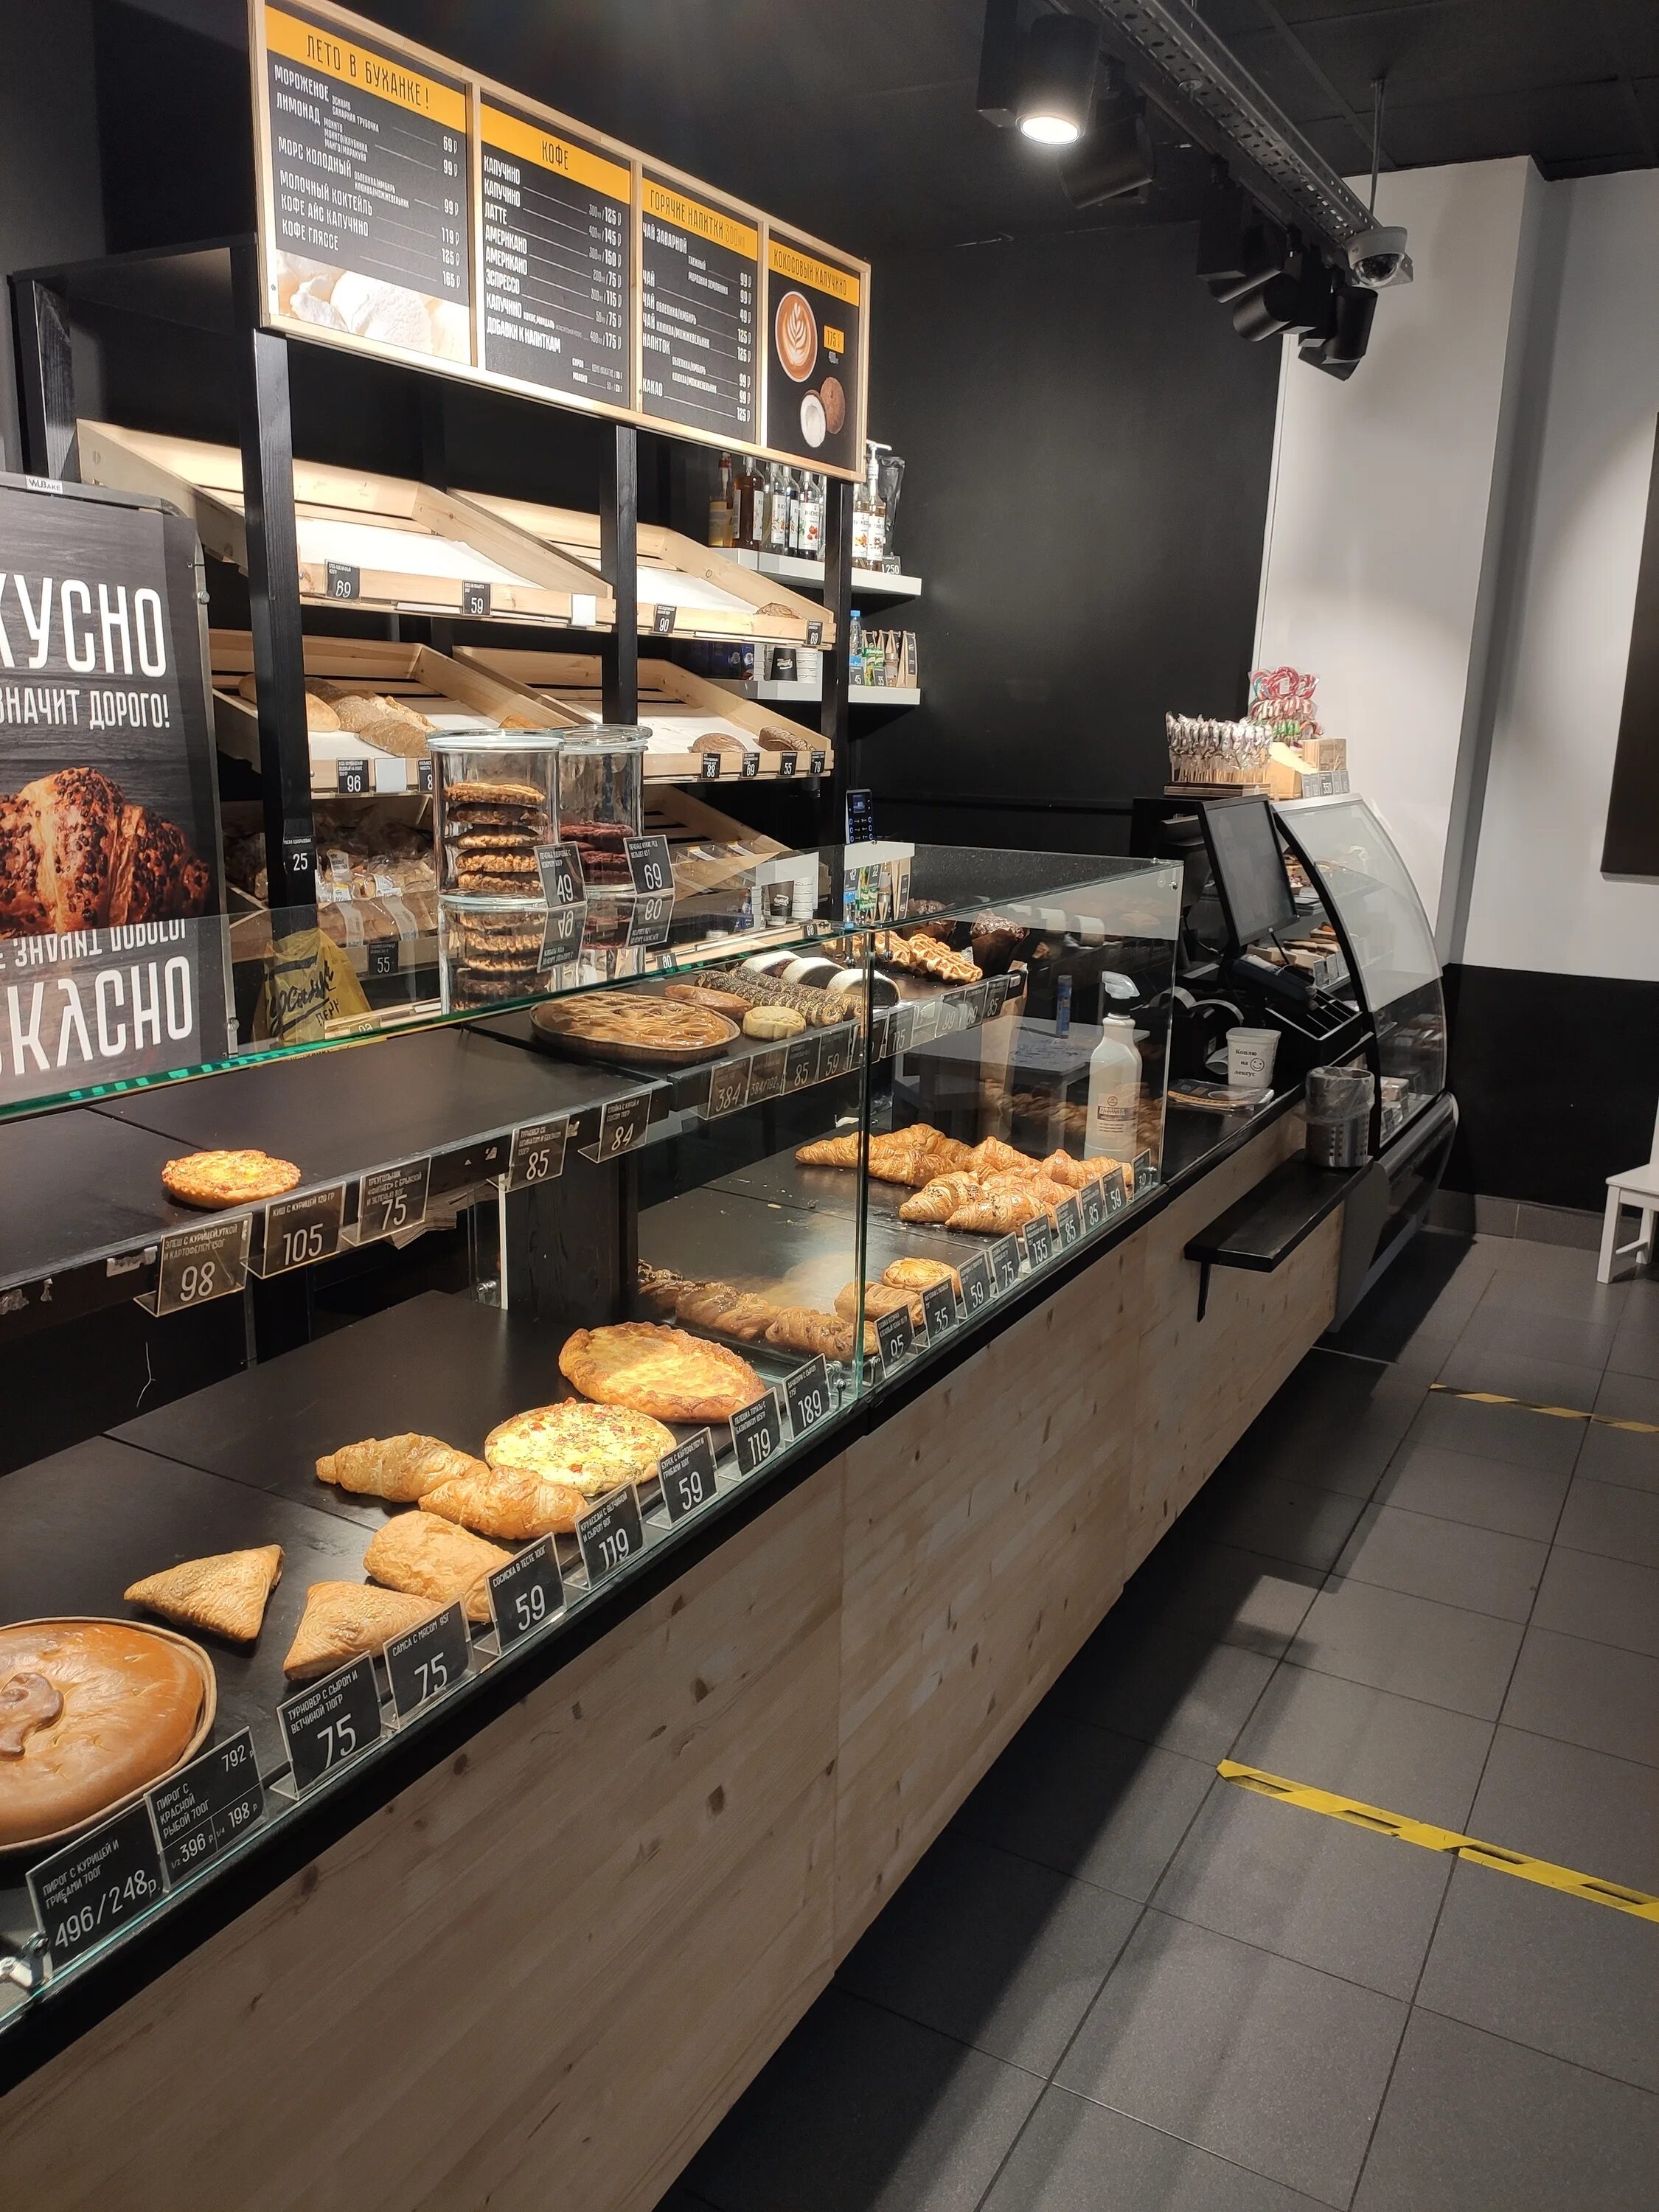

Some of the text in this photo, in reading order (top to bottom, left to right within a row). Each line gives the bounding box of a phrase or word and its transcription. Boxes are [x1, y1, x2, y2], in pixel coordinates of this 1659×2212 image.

[307, 35, 341, 71] ЛЕТО
[349, 53, 356, 77] В
[274, 64, 330, 102] МОРОЖЕНОЕ
[276, 92, 321, 126] ЛИМОНАД
[278, 136, 352, 178] МОРС ХОЛОДНЫЙ
[542, 140, 568, 170] КОФЕ
[484, 155, 521, 185] КАПУЧИНО
[280, 170, 373, 216] МОЛОЧНЫЙ КОКТЕЙЛЬ
[484, 178, 521, 208] КАПУЧИНО
[281, 194, 369, 237] КОФЕ АЙС КАПУЧИНО
[485, 202, 507, 225] ЛАТТЕ
[650, 189, 723, 239] ГОРЯЧИЕ НАПИТКИ
[282, 218, 339, 252] КОФЕ ГЛЯССЕ
[485, 224, 527, 254] АМЕРИКАНО
[643, 222, 687, 254] ЧАЙ ЗАВАРНОЙ
[486, 246, 528, 276] АМЕРИКАНО
[774, 248, 846, 296] КОКОСОВЫЙ КАПУЧИНО
[486, 268, 520, 295] ЭСПРЕССО
[643, 270, 655, 287] ЧАЙ
[487, 292, 522, 319] КАПУЧИНО
[643, 293, 655, 310] ЧАЙ
[487, 316, 518, 341] ДОБАВКИ
[519, 326, 524, 343] К
[525, 328, 561, 354] НАПИТКАМ
[643, 313, 655, 330] ЧАЙ
[643, 333, 671, 355] НАПИТОК
[643, 378, 663, 397] КАКАО
[335, 580, 351, 598] 69
[471, 597, 483, 613] 59
[659, 618, 669, 632] 90
[810, 632, 818, 644] 69
[90, 689, 170, 731] ДОРОГО!
[707, 765, 715, 777] 88
[747, 764, 754, 776] 69
[785, 763, 792, 774] 55
[347, 775, 361, 792] 96
[293, 853, 308, 871] 25
[557, 874, 574, 902] 49
[644, 863, 662, 890] 69
[377, 956, 390, 973] 55
[942, 1012, 956, 1030] 99
[987, 998, 998, 1017] 85
[893, 1029, 905, 1052] 115
[794, 1062, 810, 1086] 85
[825, 1053, 839, 1077] 59
[716, 1082, 741, 1112] 384
[611, 1123, 634, 1151] 84
[526, 1149, 550, 1180] 85
[273, 1207, 285, 1217] КИШ
[287, 1206, 291, 1214] С
[292, 1197, 317, 1212] КУРИЦЕЙ
[381, 1194, 407, 1231] 75
[1110, 1189, 1121, 1210] 59
[1089, 1203, 1099, 1225] 85
[283, 1223, 324, 1265] 105
[1065, 1220, 1077, 1243] 85
[170, 1242, 210, 1260] КАРТОФЕЛЕМ
[1032, 1237, 1047, 1264] 135
[180, 1262, 215, 1301] 98
[1002, 1261, 1014, 1287] 75
[970, 1281, 984, 1308] 59
[934, 1307, 948, 1334] 35
[798, 1389, 822, 1427] 189
[661, 1440, 700, 1470] БУРЕК КАРТОФЕЛЕМ
[748, 1428, 771, 1466] 119
[663, 1464, 681, 1481] ГРИБАМИ
[679, 1471, 703, 1510] 59
[580, 1490, 628, 1533] КРУАССАН С ВЕТЧИНОЙ
[582, 1534, 587, 1543] И
[587, 1523, 603, 1540] СЫРОМ
[599, 1528, 629, 1571] 119
[493, 1567, 516, 1587] СОСИСКА
[516, 1562, 521, 1573] В
[520, 1554, 535, 1569] ТЕСТЕ
[515, 1585, 545, 1631] 59
[392, 1637, 412, 1657] САМСА
[413, 1634, 417, 1644] С
[414, 1652, 448, 1702] 75
[288, 1669, 358, 1721] ТУРНОВЕР С СЫРОМ И
[291, 1693, 343, 1735] ВЕТЧИНОЙ 110ГР
[317, 1713, 356, 1770] 75
[221, 1745, 246, 1773] 792
[156, 1783, 189, 1811] ПИРОГ С
[160, 1792, 195, 1826] КРАСНОЙ
[163, 1799, 209, 1839] РЫБОЙ 700Г
[228, 1802, 251, 1829] 198
[180, 1833, 206, 1863] 396
[42, 1839, 119, 1896] ПИРОГ С КУРИЦЕЙ И
[46, 1865, 102, 1910] ГРИБАМИ 700Г
